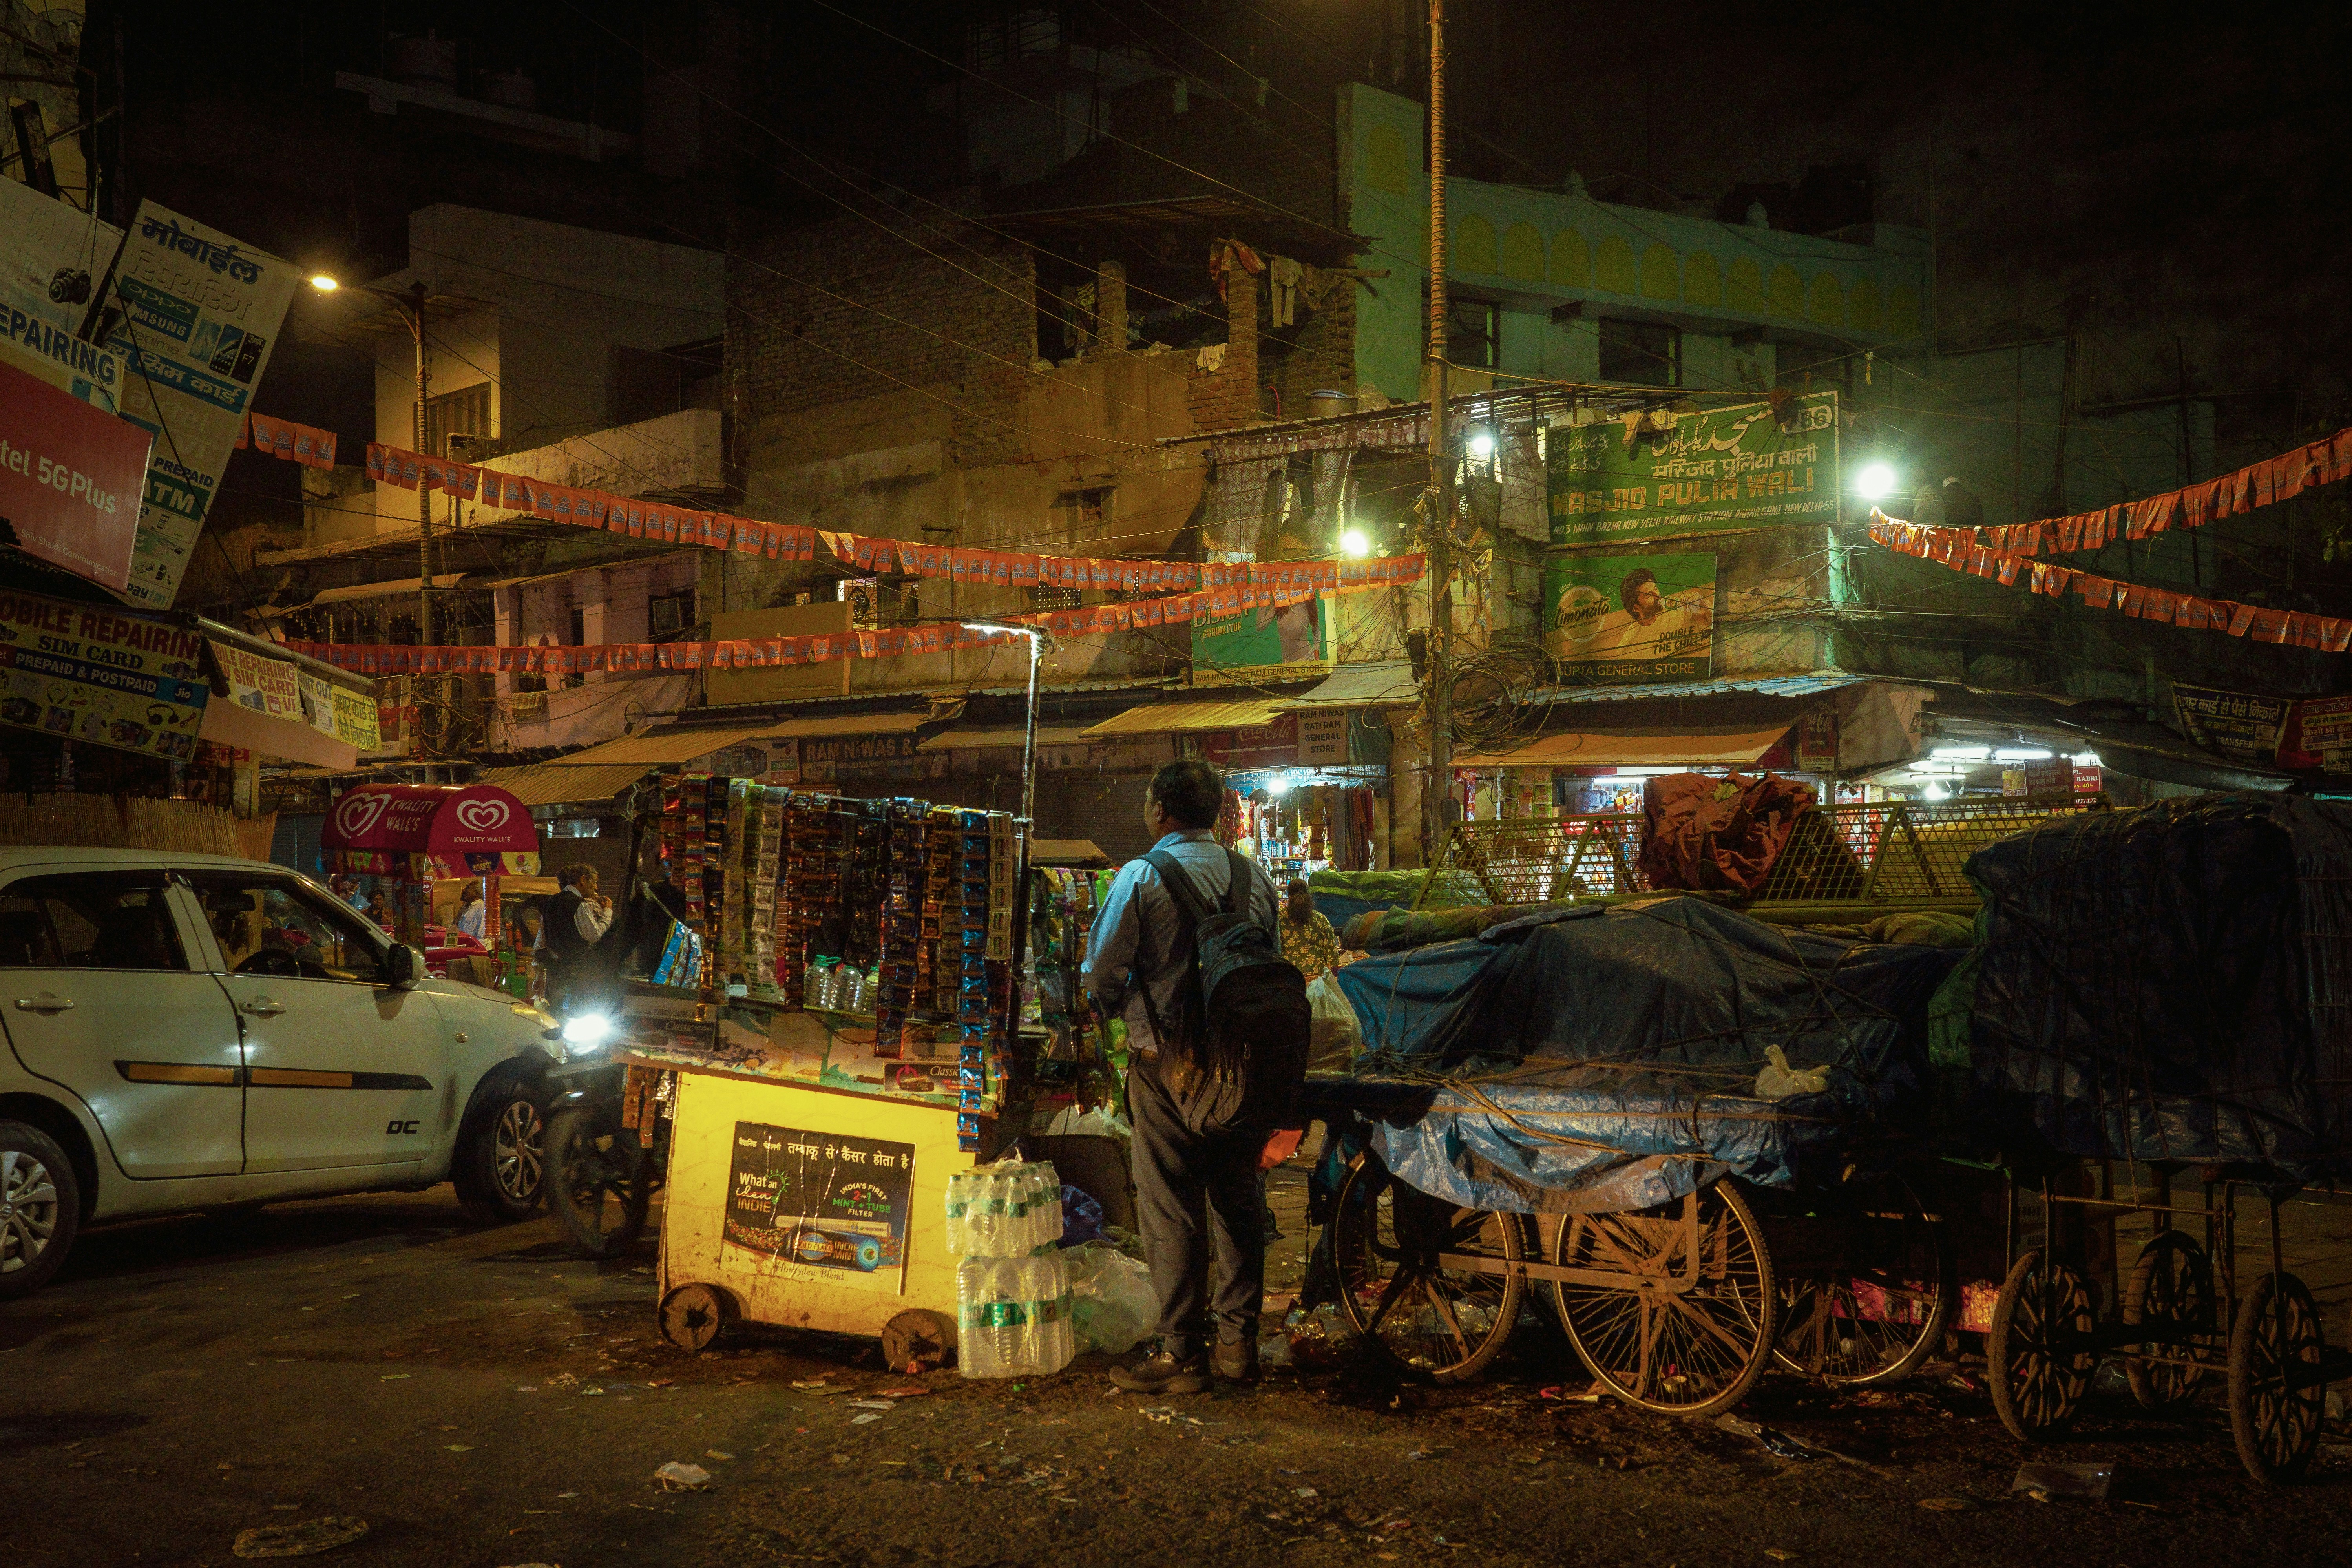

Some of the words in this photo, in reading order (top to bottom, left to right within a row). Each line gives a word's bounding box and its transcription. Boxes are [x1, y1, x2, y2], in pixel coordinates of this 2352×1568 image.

[141, 215, 264, 285] मोबाईल
[242, 354, 255, 365] F7
[137, 351, 187, 383] सिम
[190, 375, 243, 405] कार्ड
[1778, 443, 1818, 465] वाली
[154, 456, 214, 487] PREPAID
[1553, 487, 1646, 516] MASJID
[1658, 478, 1738, 507] PULIA
[1747, 467, 1813, 498] WALI
[1573, 523, 1593, 533] MAIN
[1596, 520, 1621, 531] BAZAR
[1623, 519, 1639, 529] NEW
[1698, 510, 1732, 522] STATION
[1784, 503, 1801, 514] NEW
[21, 529, 37, 541] Shiv
[63, 547, 118, 577] Communication
[1554, 596, 1611, 629] Limonata
[1659, 626, 1695, 642] DOUBLE
[38, 636, 80, 657] SIM
[86, 646, 143, 669] CARD
[1653, 643, 1671, 655] THE
[16, 653, 73, 675] PREPAID
[77, 666, 87, 678] &
[91, 668, 157, 693] POSTPAID
[238, 652, 295, 681] REPAIRING
[1268, 667, 1298, 676] GENERAL
[1301, 664, 1324, 673] STORE
[1598, 664, 1652, 676] GENERAL
[1656, 662, 1695, 675] STORE
[234, 668, 256, 688] SIM
[259, 675, 296, 696] CARD
[317, 681, 332, 700] OUT
[174, 687, 191, 699] Jio
[352, 696, 366, 720] कार्ड
[1319, 709, 1344, 717] NIWAS
[2199, 695, 2220, 714] कार्ड
[2221, 697, 2230, 714] से
[2231, 697, 2247, 717] पैसे
[1305, 733, 1340, 741] GENERAL
[807, 744, 839, 761] RAM
[844, 739, 896, 760] NIWAS
[389, 800, 438, 812] KWALITY
[386, 816, 420, 832] WALL'S
[930, 1066, 959, 1076] Classic
[386, 1121, 420, 1134] DC
[787, 1143, 819, 1161] तम्बाकू
[825, 1144, 835, 1160] से
[841, 1145, 867, 1164] कैंसर
[873, 1150, 895, 1167] होता
[901, 1153, 909, 1169] है
[740, 1172, 767, 1187] What
[768, 1181, 777, 1189] an
[736, 1186, 772, 1201] idea
[840, 1183, 867, 1196] INDIA'S
[868, 1184, 887, 1201] FIRST
[738, 1198, 771, 1213] INDIE
[832, 1197, 856, 1208] MINT
[866, 1202, 891, 1213] TUBE
[848, 1208, 873, 1217] FILTER
[820, 1270, 844, 1281] Blend
